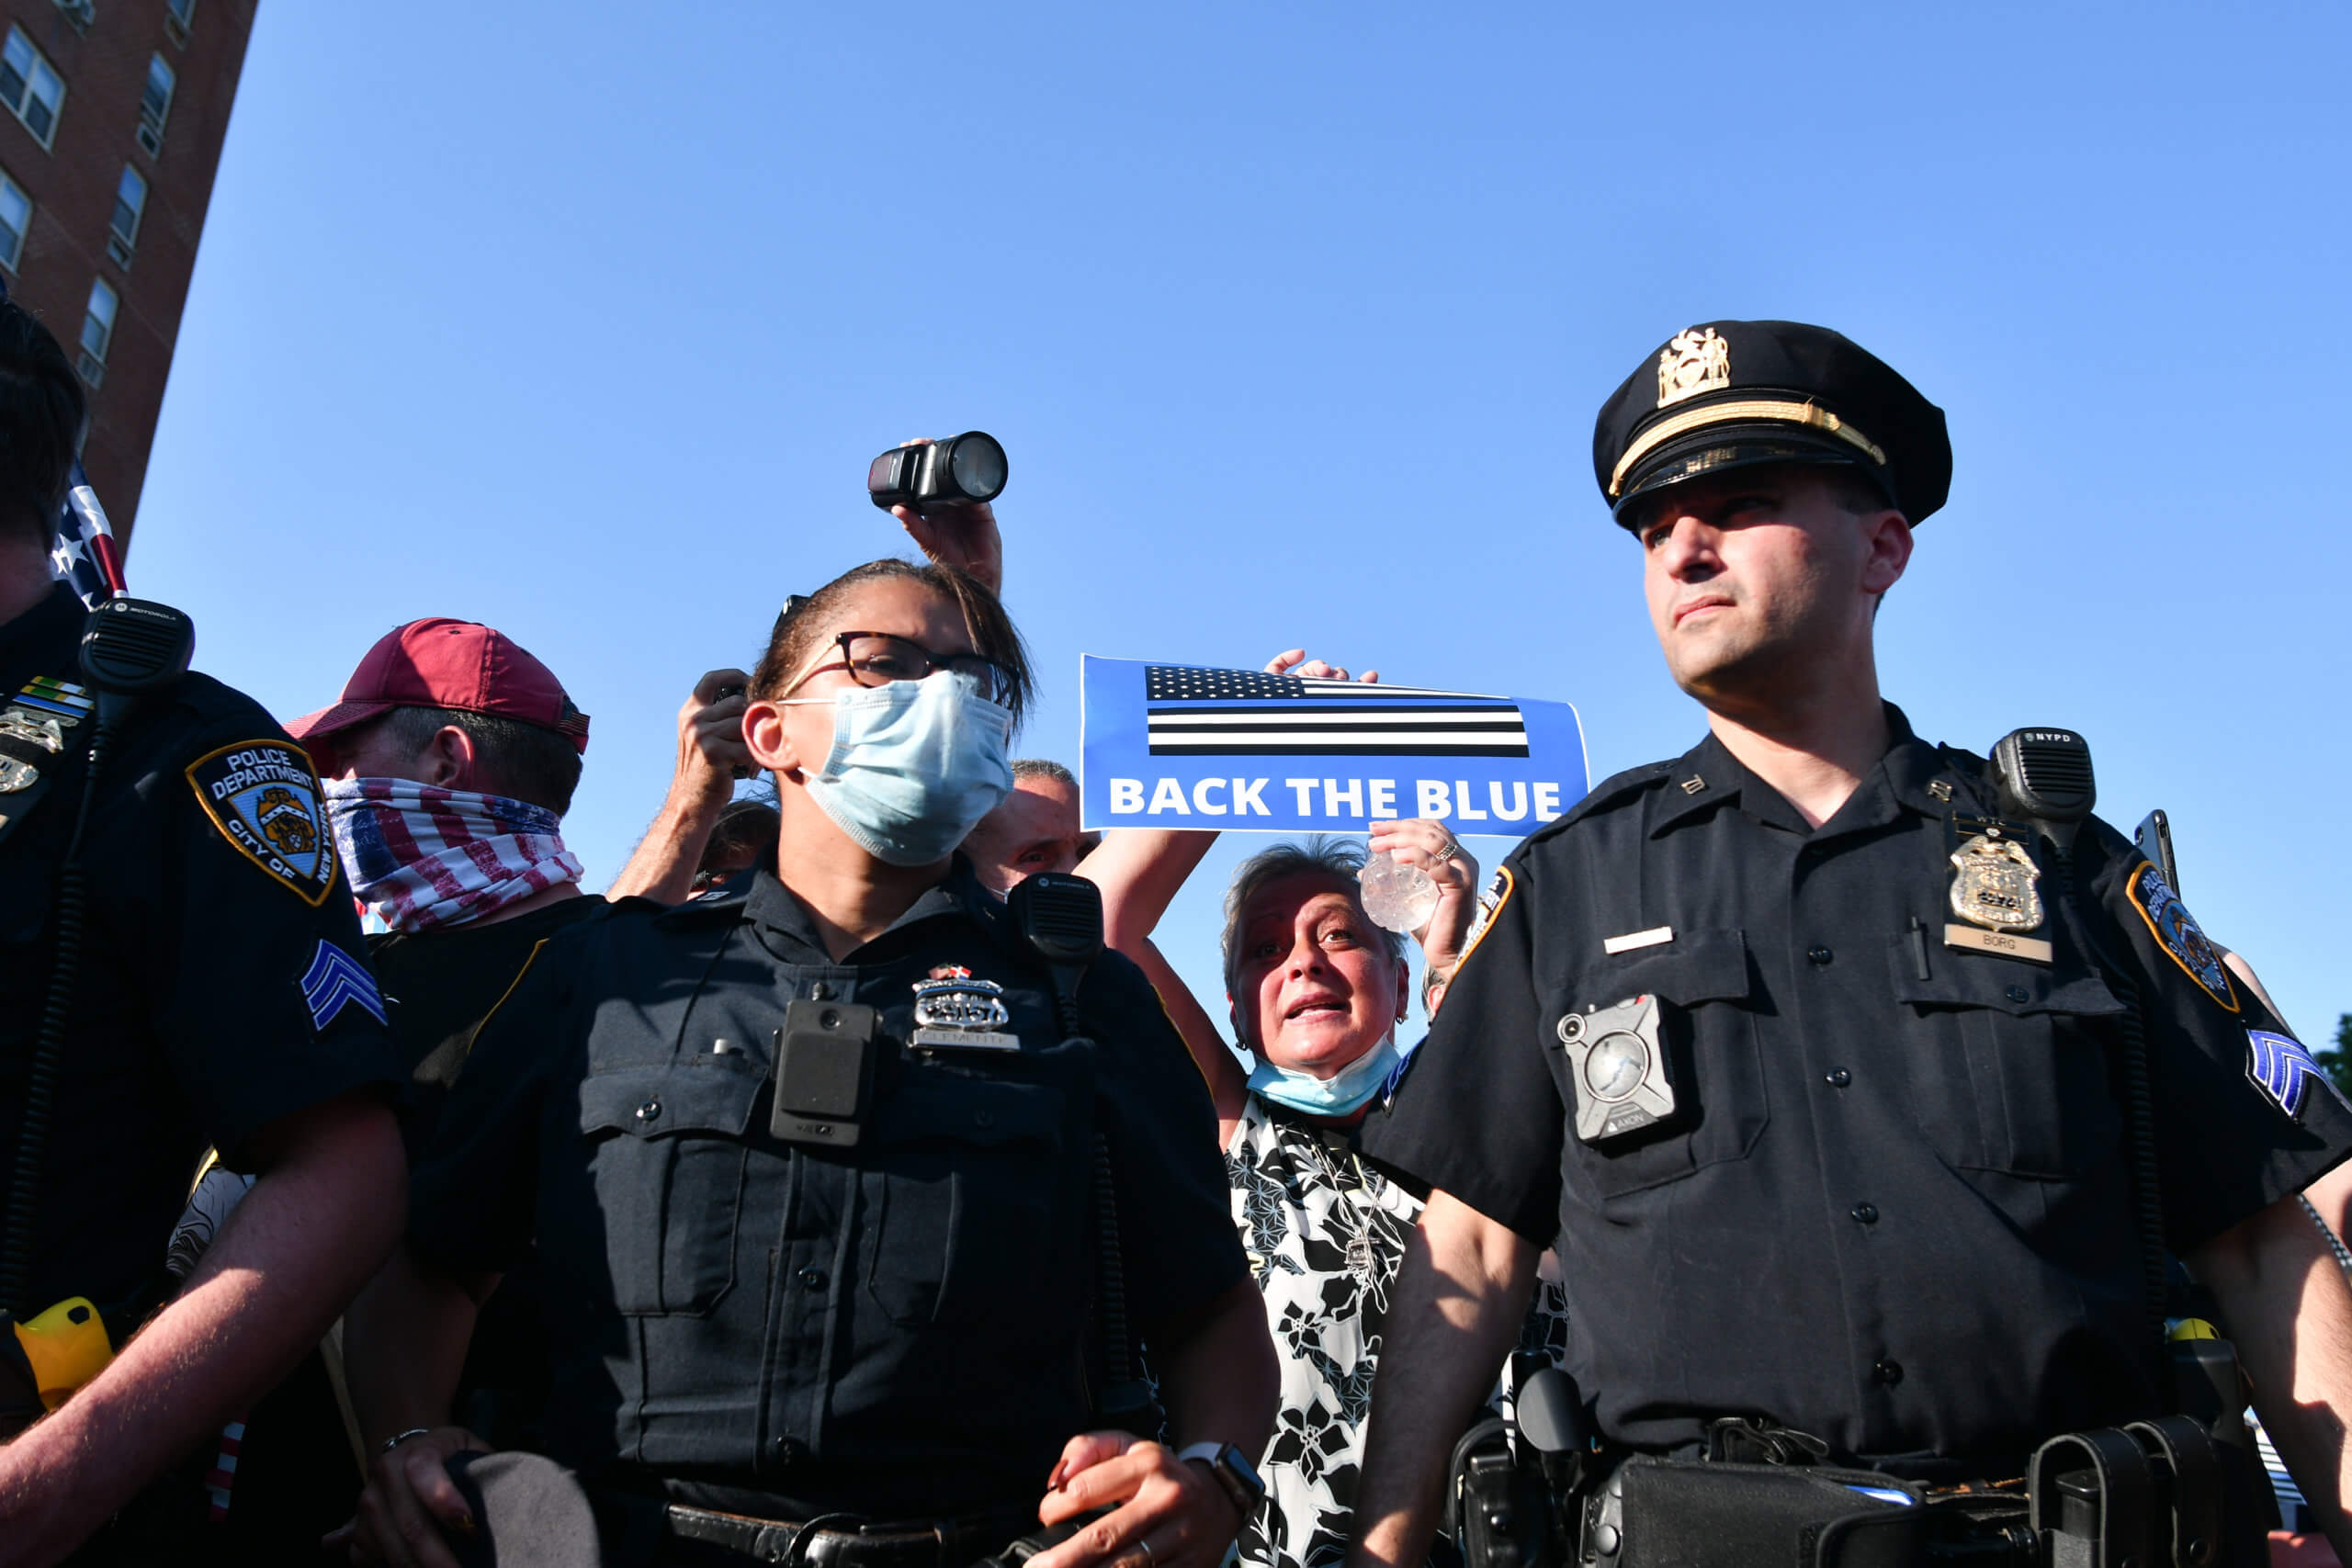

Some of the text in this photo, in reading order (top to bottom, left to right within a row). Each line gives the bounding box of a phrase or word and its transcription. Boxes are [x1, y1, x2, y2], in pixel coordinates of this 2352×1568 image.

[2035, 733, 2071, 742] NYPD
[226, 749, 292, 772] POLICE
[211, 764, 315, 800] DEPARTMENT
[1110, 777, 1562, 823] BACK THE BLUE
[228, 818, 296, 879] CITY OF
[317, 802, 332, 885] NEW YORK
[1983, 934, 2017, 950] BORG
